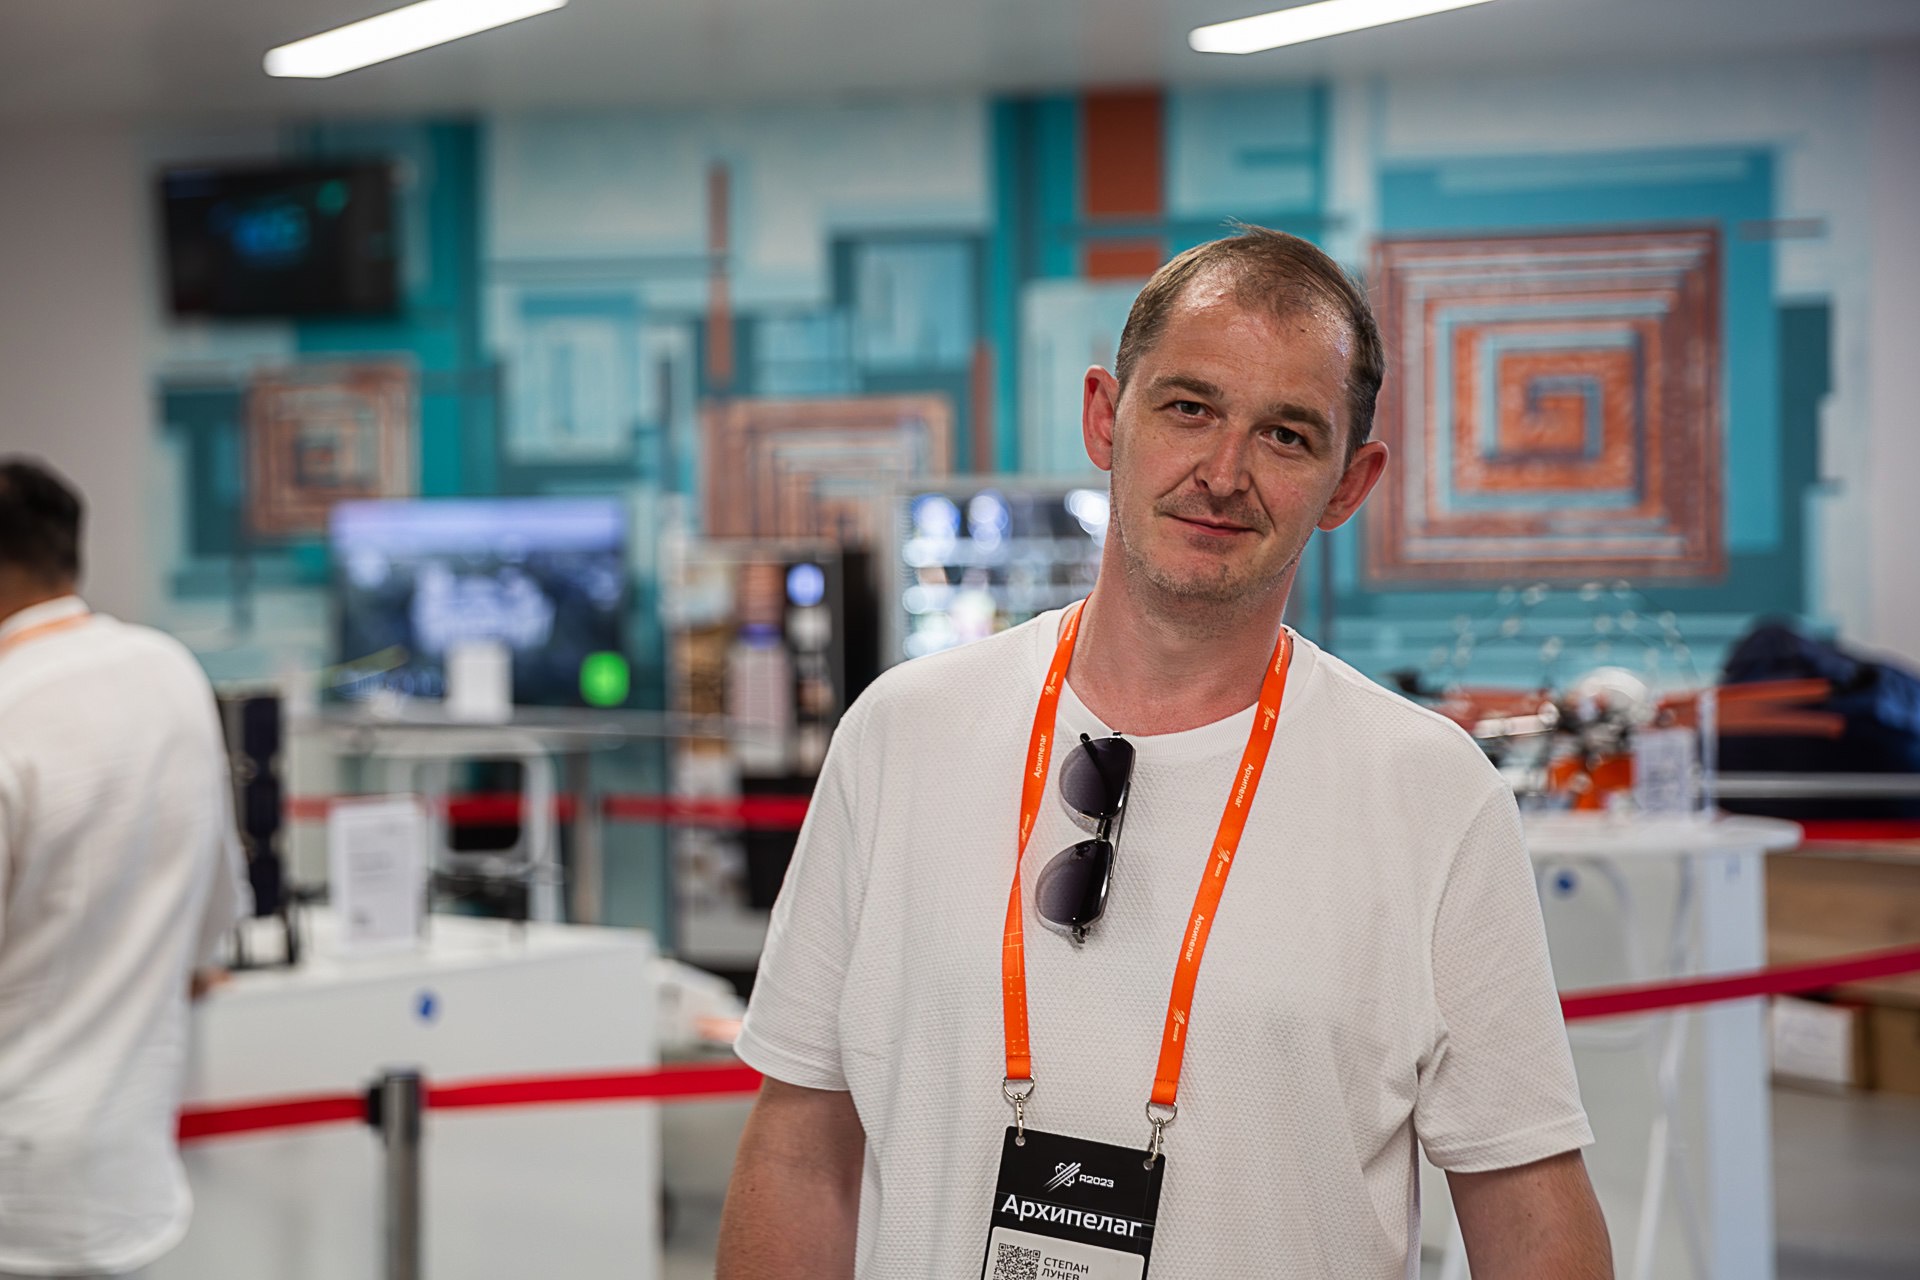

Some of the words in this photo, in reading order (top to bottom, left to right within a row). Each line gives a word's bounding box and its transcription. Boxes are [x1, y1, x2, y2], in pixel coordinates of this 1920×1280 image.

[1033, 734, 1047, 778] Архипелаг
[1234, 763, 1255, 808] Архипелаг
[1185, 913, 1205, 962] Архипелаг
[1001, 1194, 1142, 1237] Архипелаг
[1043, 1257, 1089, 1274] СТЕПАН
